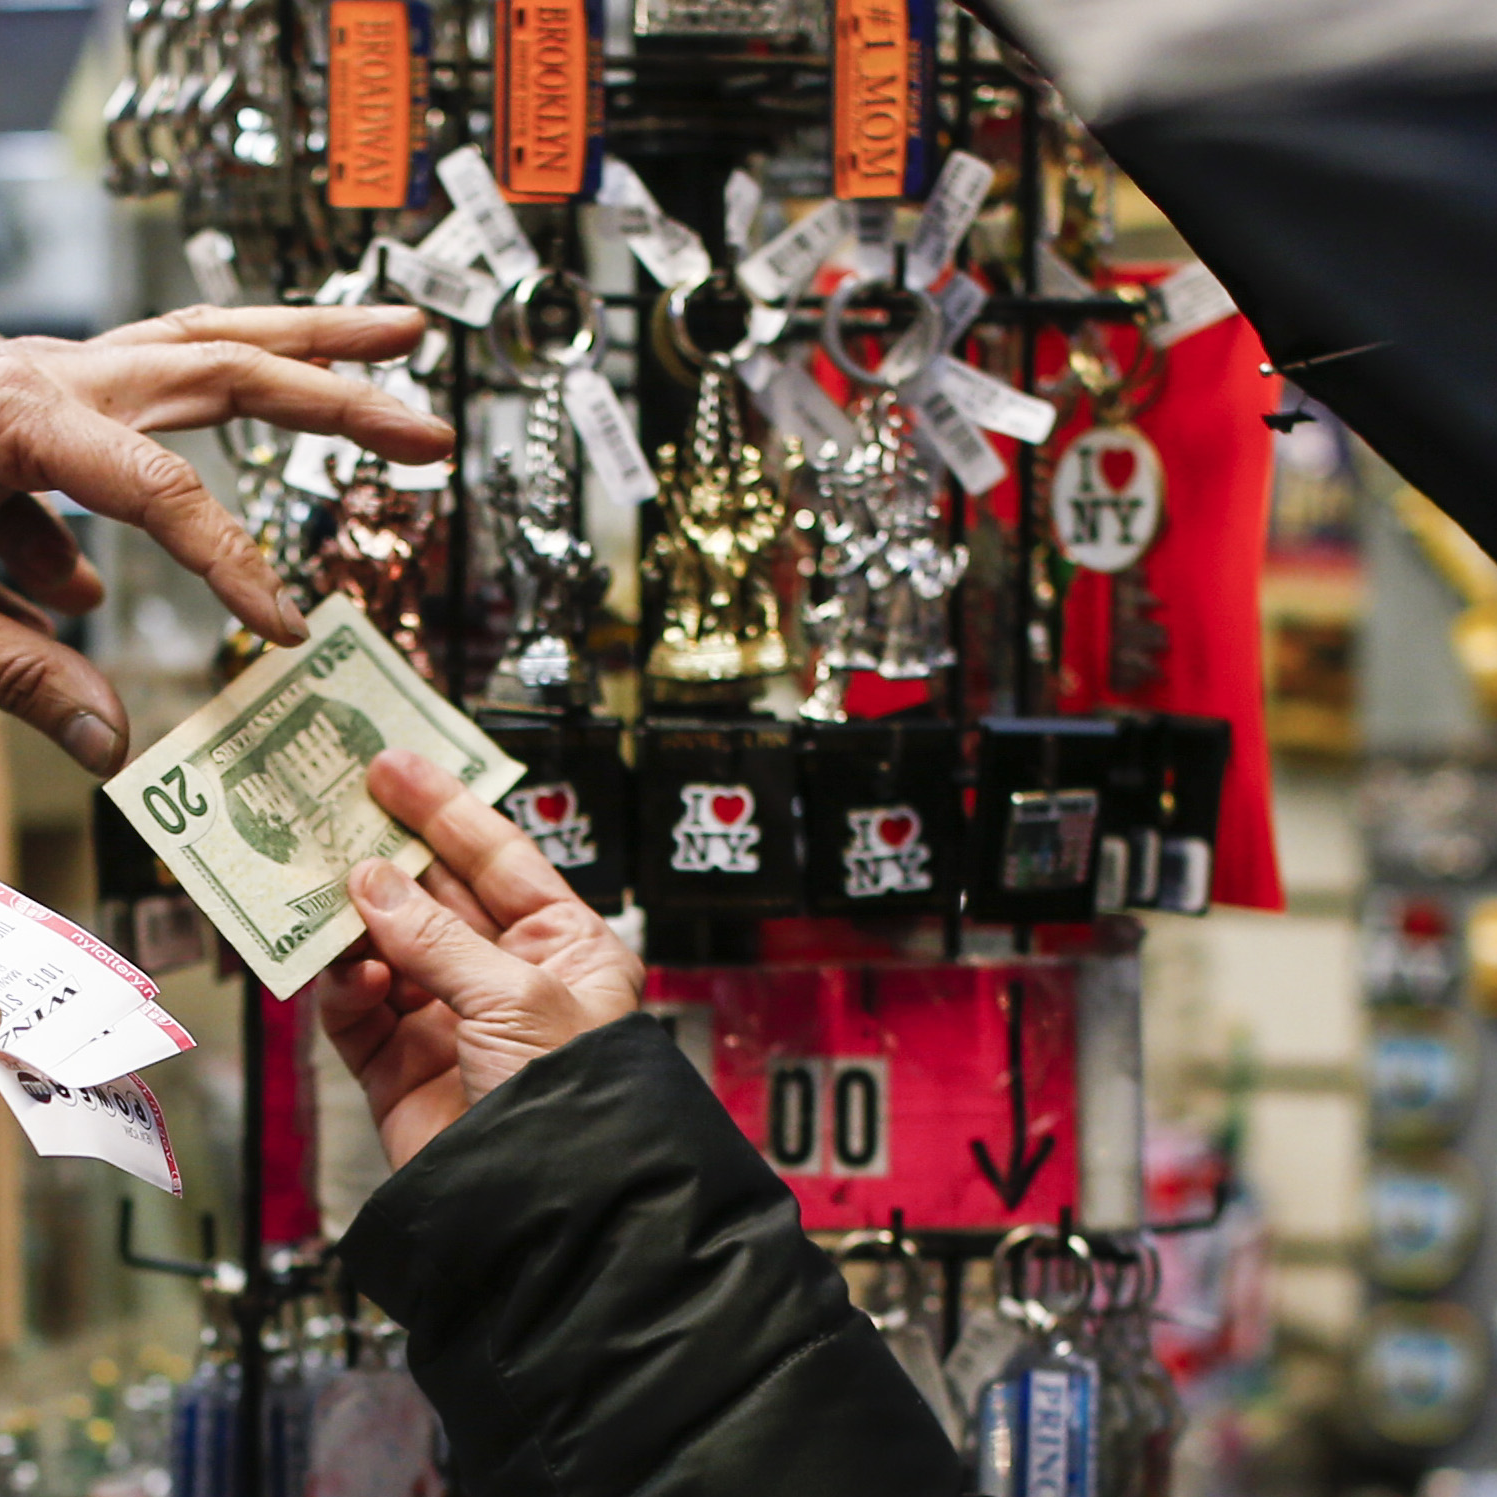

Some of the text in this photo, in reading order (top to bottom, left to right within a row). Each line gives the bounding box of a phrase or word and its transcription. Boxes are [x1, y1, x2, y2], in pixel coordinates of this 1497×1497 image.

[356, 20, 396, 192] BROADWAY
[535, 6, 571, 173] BROOKLYN
[860, 75, 899, 179] MOM
[1069, 499, 1144, 549] NY
[306, 630, 358, 681] 20
[141, 764, 209, 836] 20
[675, 833, 760, 871] NY
[847, 854, 931, 895] NY
[274, 921, 311, 956] 20
[26, 958, 65, 995] 1015
[771, 1064, 879, 1168] 00
